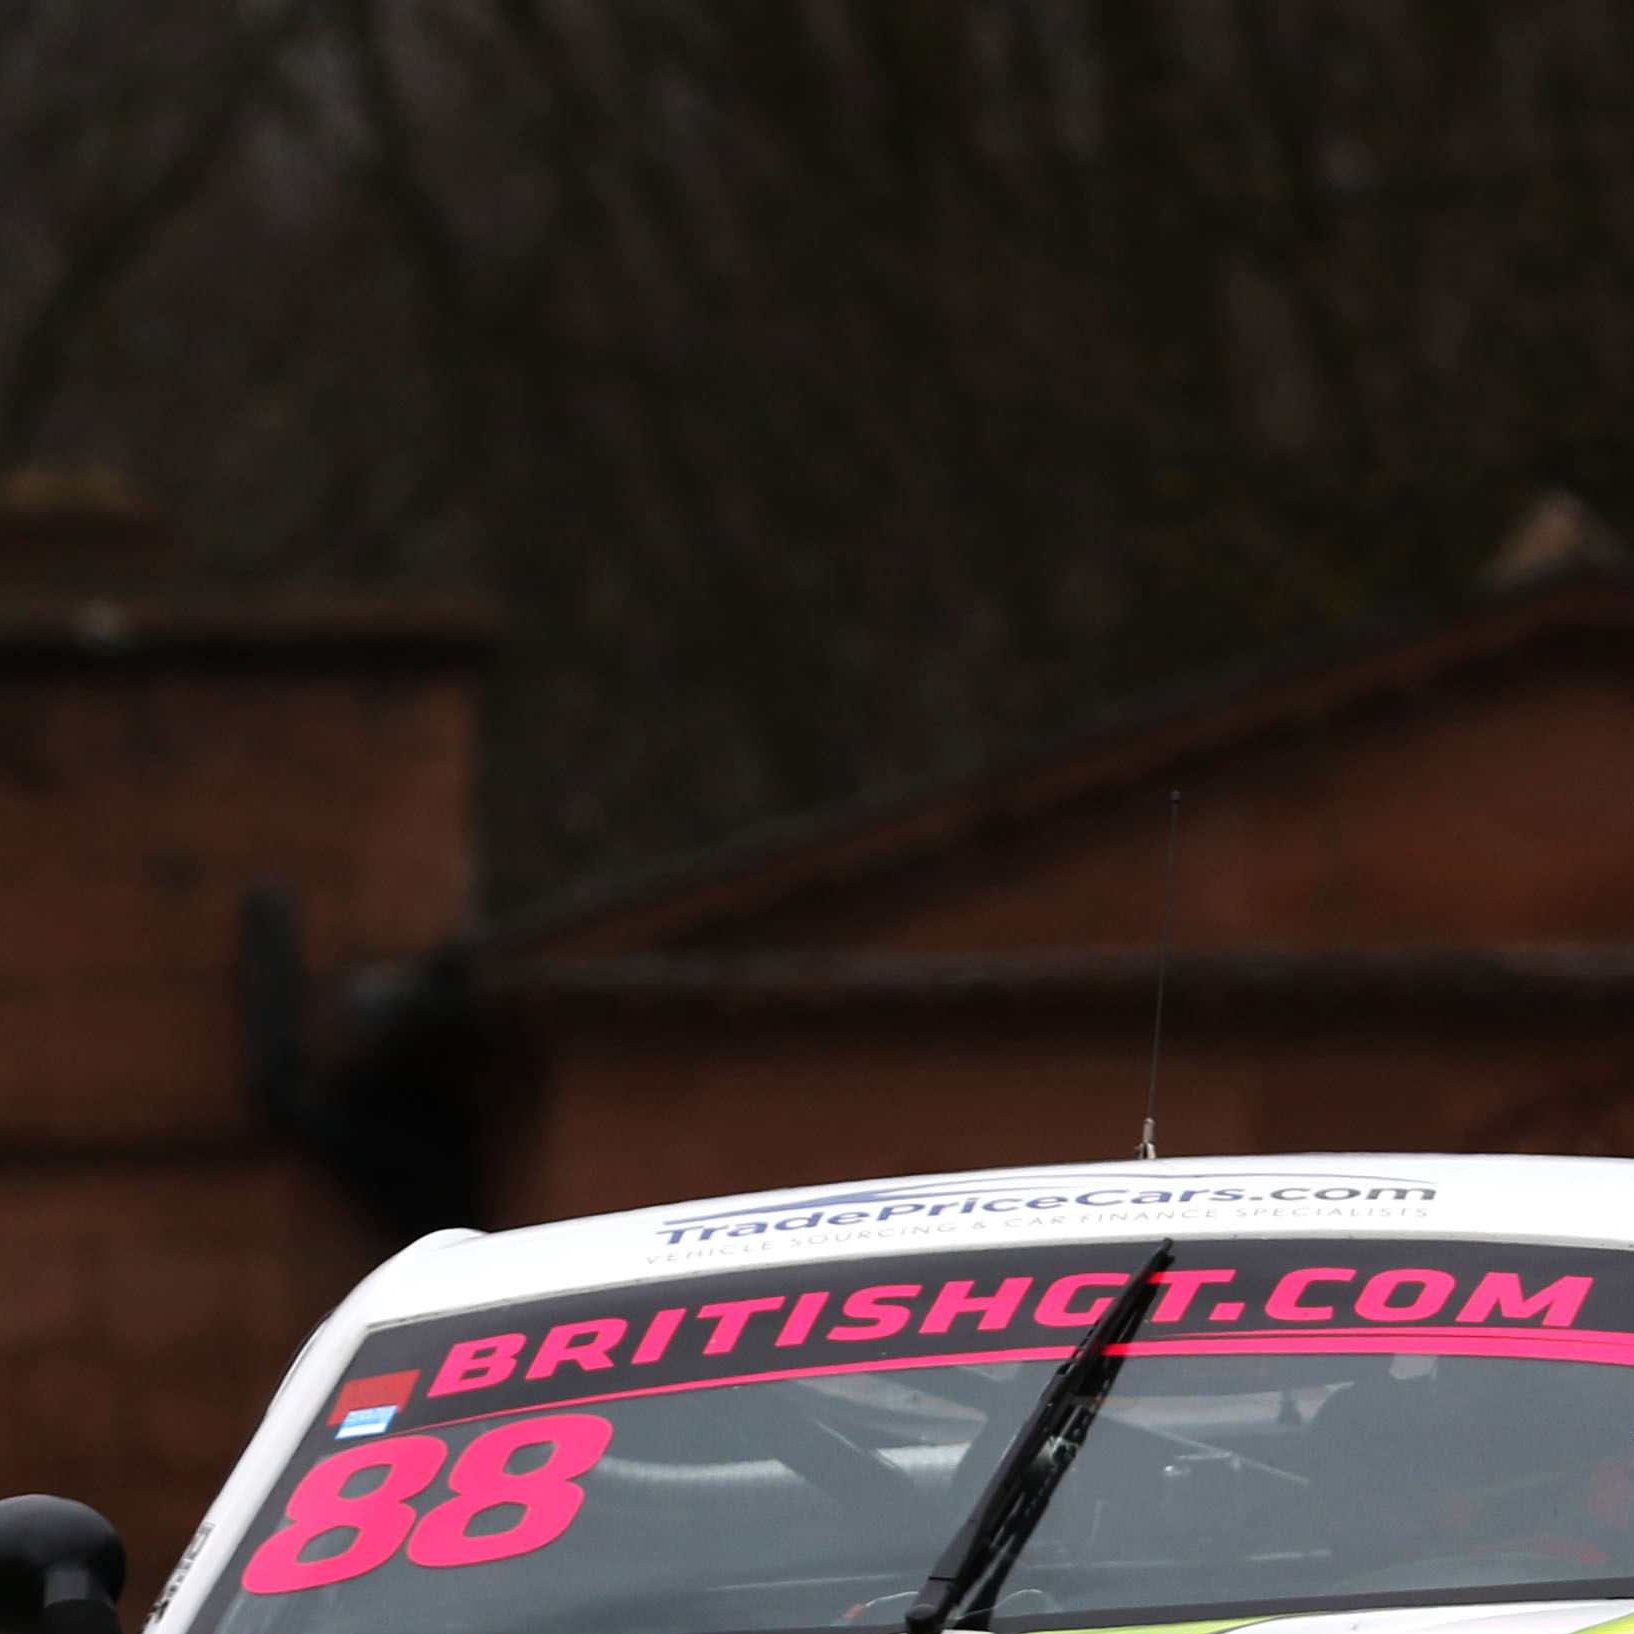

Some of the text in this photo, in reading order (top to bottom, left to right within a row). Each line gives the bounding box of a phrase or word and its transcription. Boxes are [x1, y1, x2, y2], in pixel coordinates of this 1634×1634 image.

[645, 1240, 772, 1265] VEHICLE
[790, 1223, 931, 1248] SOURCING
[1004, 1215, 1065, 1228] CAR
[1080, 1207, 1218, 1223] FINANCE
[1235, 1205, 1429, 1218] SPECIALISTS
[655, 1184, 1438, 1245] TradePriceCars.com
[427, 1267, 1594, 1398] BRITISHGT.COM
[241, 1413, 614, 1595] 88
